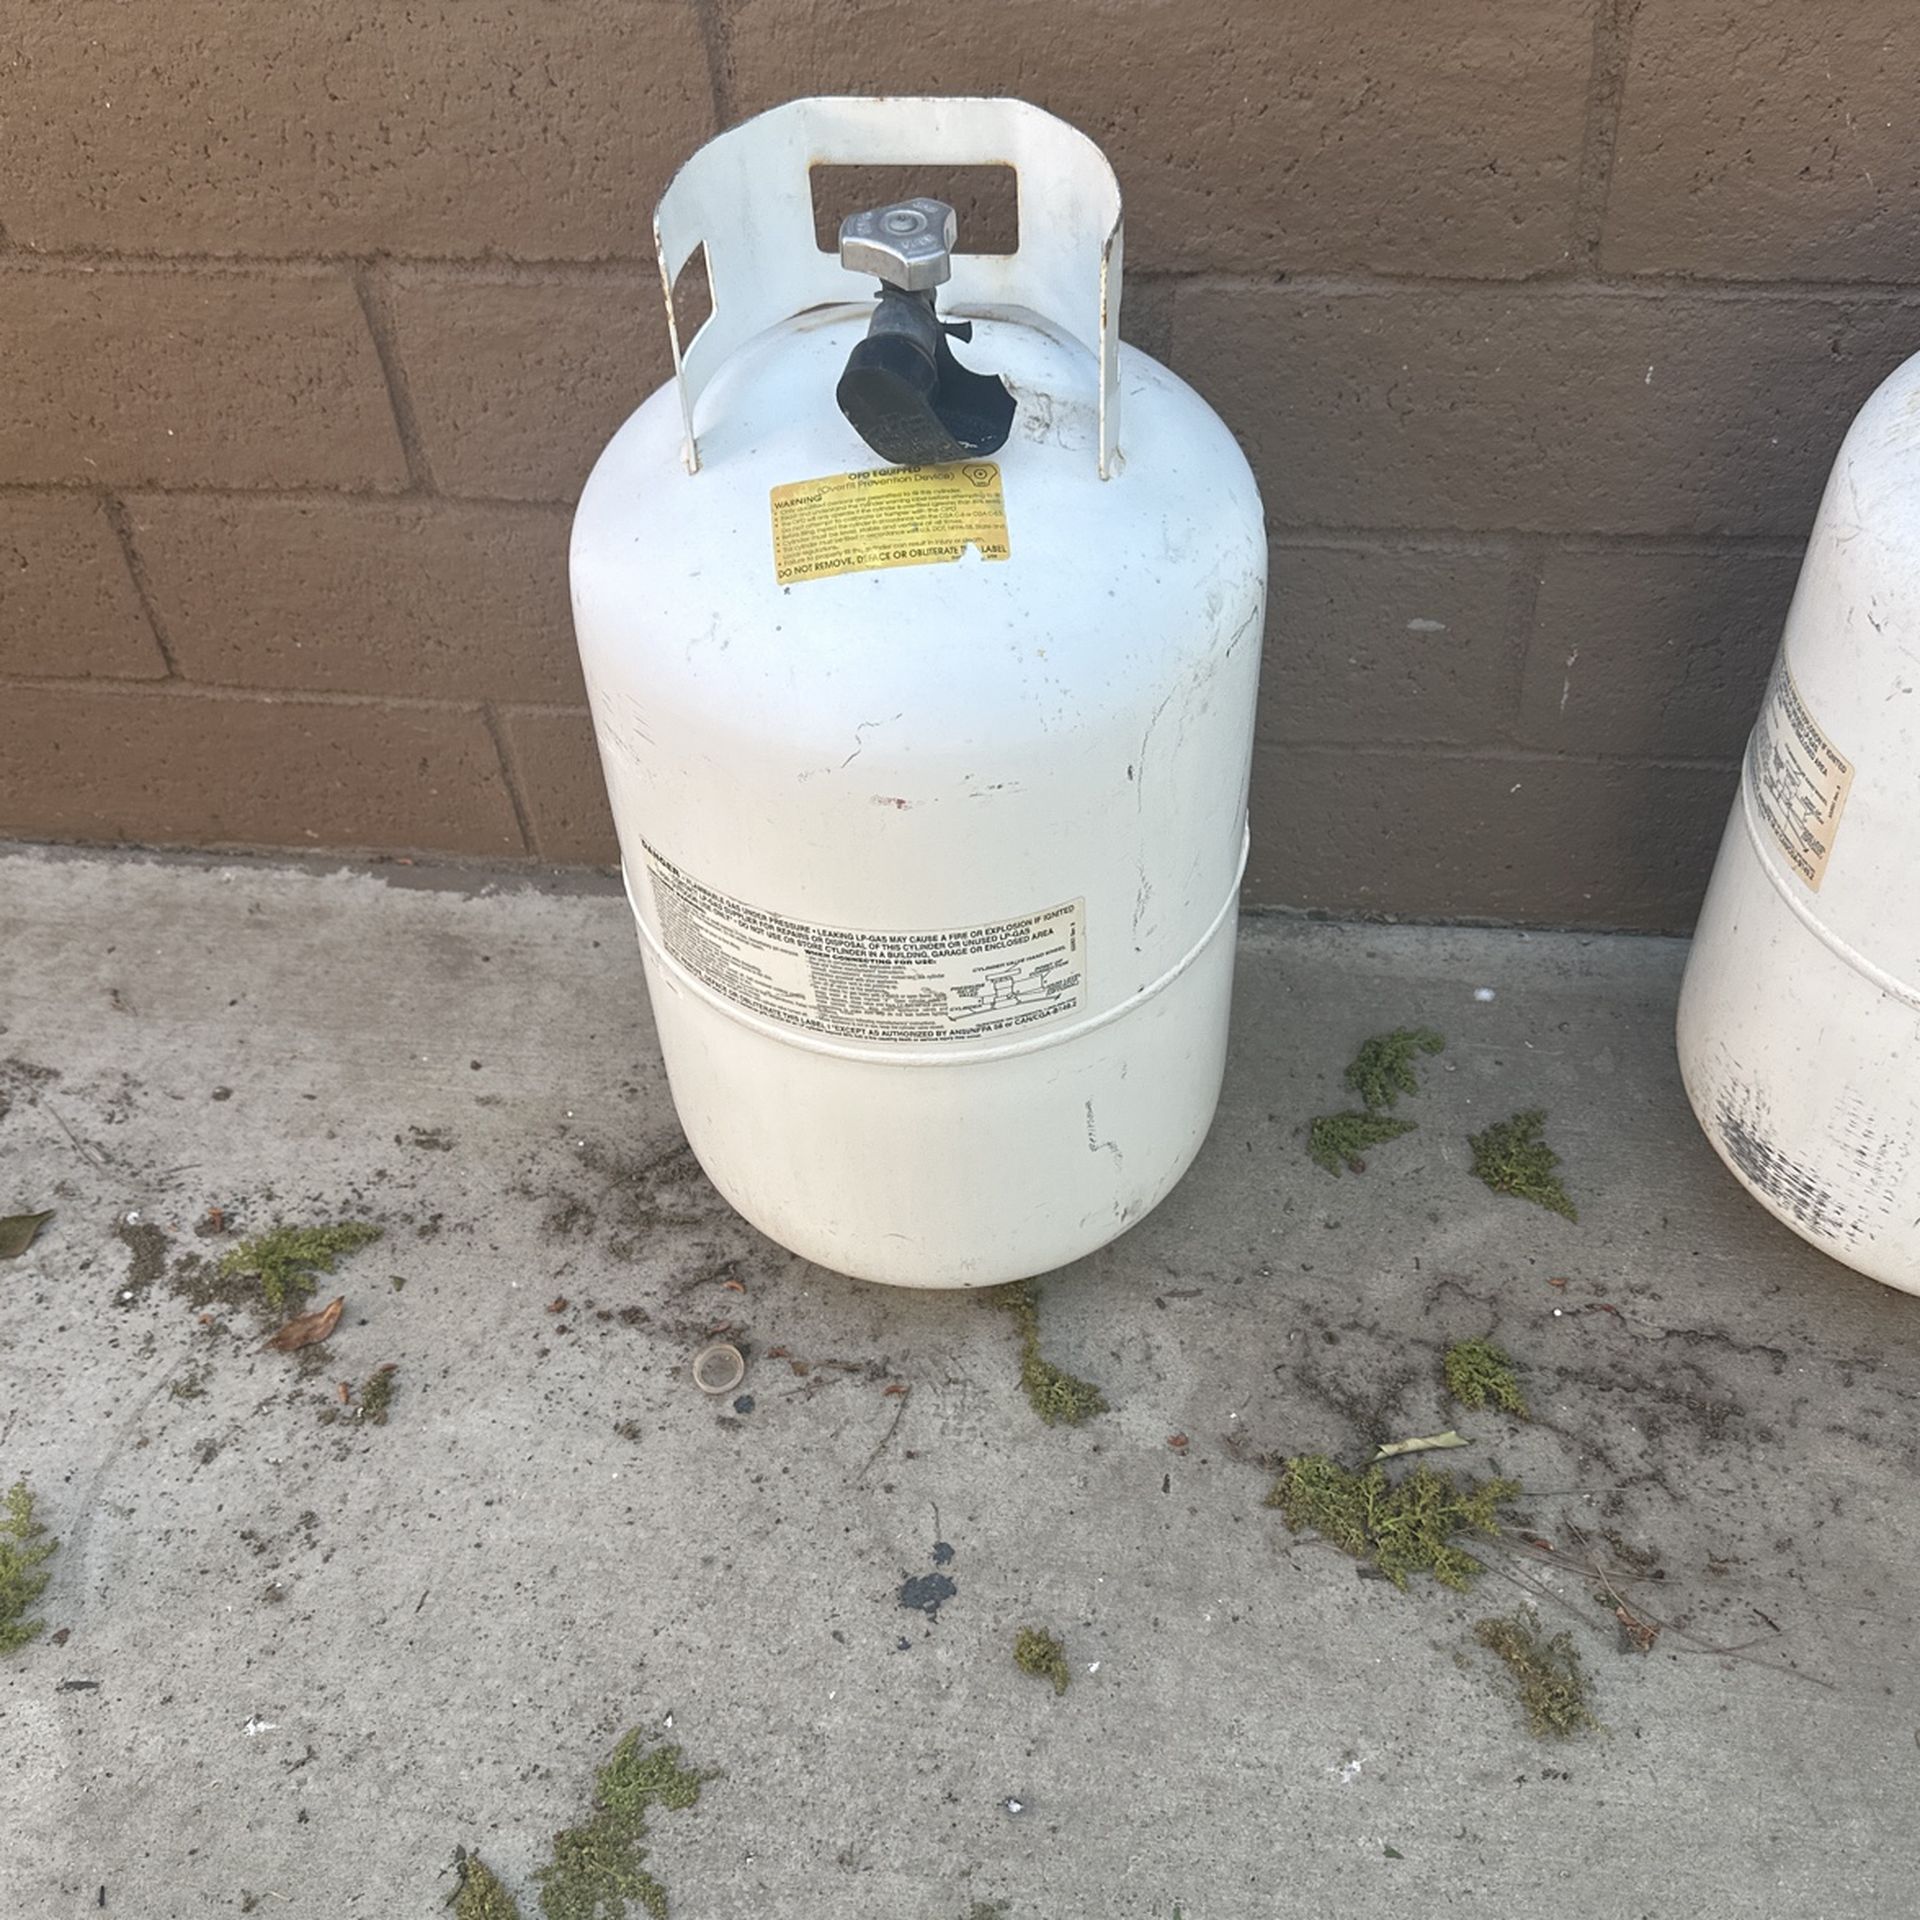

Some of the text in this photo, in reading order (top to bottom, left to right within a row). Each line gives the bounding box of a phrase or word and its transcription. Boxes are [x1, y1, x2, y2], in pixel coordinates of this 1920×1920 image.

[857, 475, 912, 488] Prevention
[914, 472, 955, 482] Device)
[774, 495, 823, 509] WARNING
[778, 568, 793, 578] DO
[794, 564, 813, 575] NOT
[815, 557, 855, 571] REMOVE,
[893, 550, 908, 560] OR
[909, 546, 959, 558] OBLITERATE
[981, 544, 1008, 553] LABEL
[1826, 749, 1848, 774] IGNITED
[641, 839, 680, 878] DANGER
[741, 908, 768, 922] UNDER
[768, 917, 811, 933] PRESSURE
[817, 928, 854, 940] LEAKING
[856, 934, 888, 942] LP-GAS
[949, 932, 968, 940] FIRE
[970, 929, 983, 937] OR
[985, 919, 1033, 934] EXPLOSION
[1043, 905, 1075, 921] IGNITED
[738, 922, 749, 931] DO
[766, 931, 782, 941] USE
[783, 936, 796, 945] OR
[797, 940, 823, 951] STORE
[825, 945, 867, 956] CYLINDER
[931, 947, 968, 957] GARAGE
[970, 945, 983, 953] OR
[985, 935, 1030, 950] ENCLOSED
[1031, 928, 1054, 940] AREA
[759, 922, 775, 932] FOR
[776, 927, 810, 940] REPAIRS
[811, 935, 823, 943] OR
[825, 938, 866, 949] DISPOSAL
[903, 942, 946, 950] CYLINDER
[947, 940, 961, 948] OR
[962, 934, 998, 946] UNUSED
[999, 927, 1031, 940] LP-GAS
[804, 949, 830, 959] WHEN
[973, 962, 1005, 972] CYLINDER
[800, 1017, 825, 1028] LABEL
